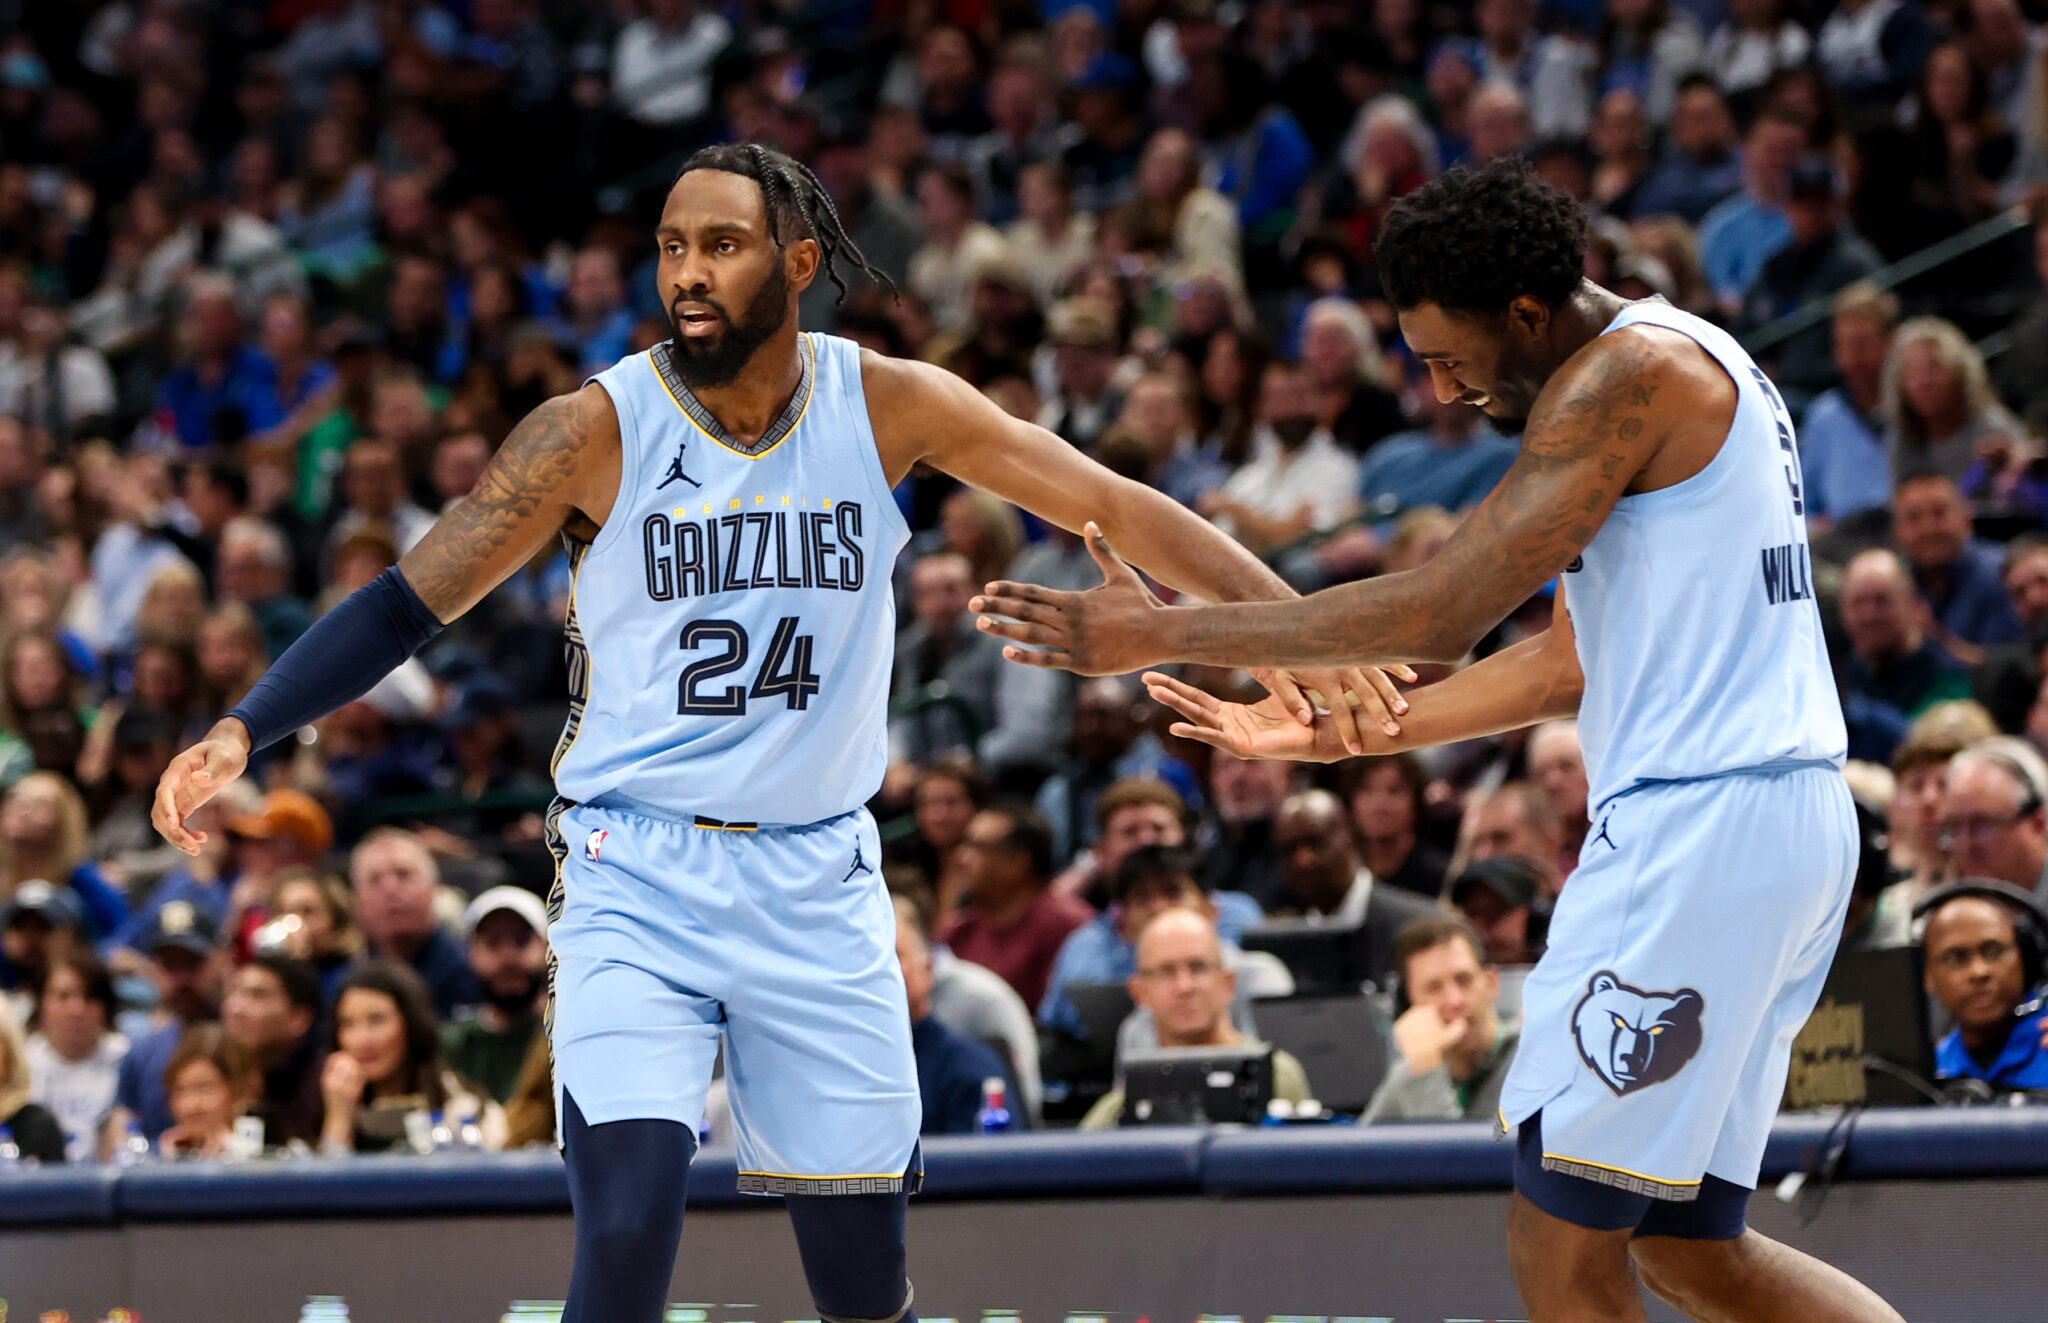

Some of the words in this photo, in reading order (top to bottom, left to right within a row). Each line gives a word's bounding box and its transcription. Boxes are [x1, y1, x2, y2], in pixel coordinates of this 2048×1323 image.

[644, 501, 864, 602] GRIZZLIES
[673, 496, 832, 519] MEMPHIS
[677, 616, 820, 716] 24
